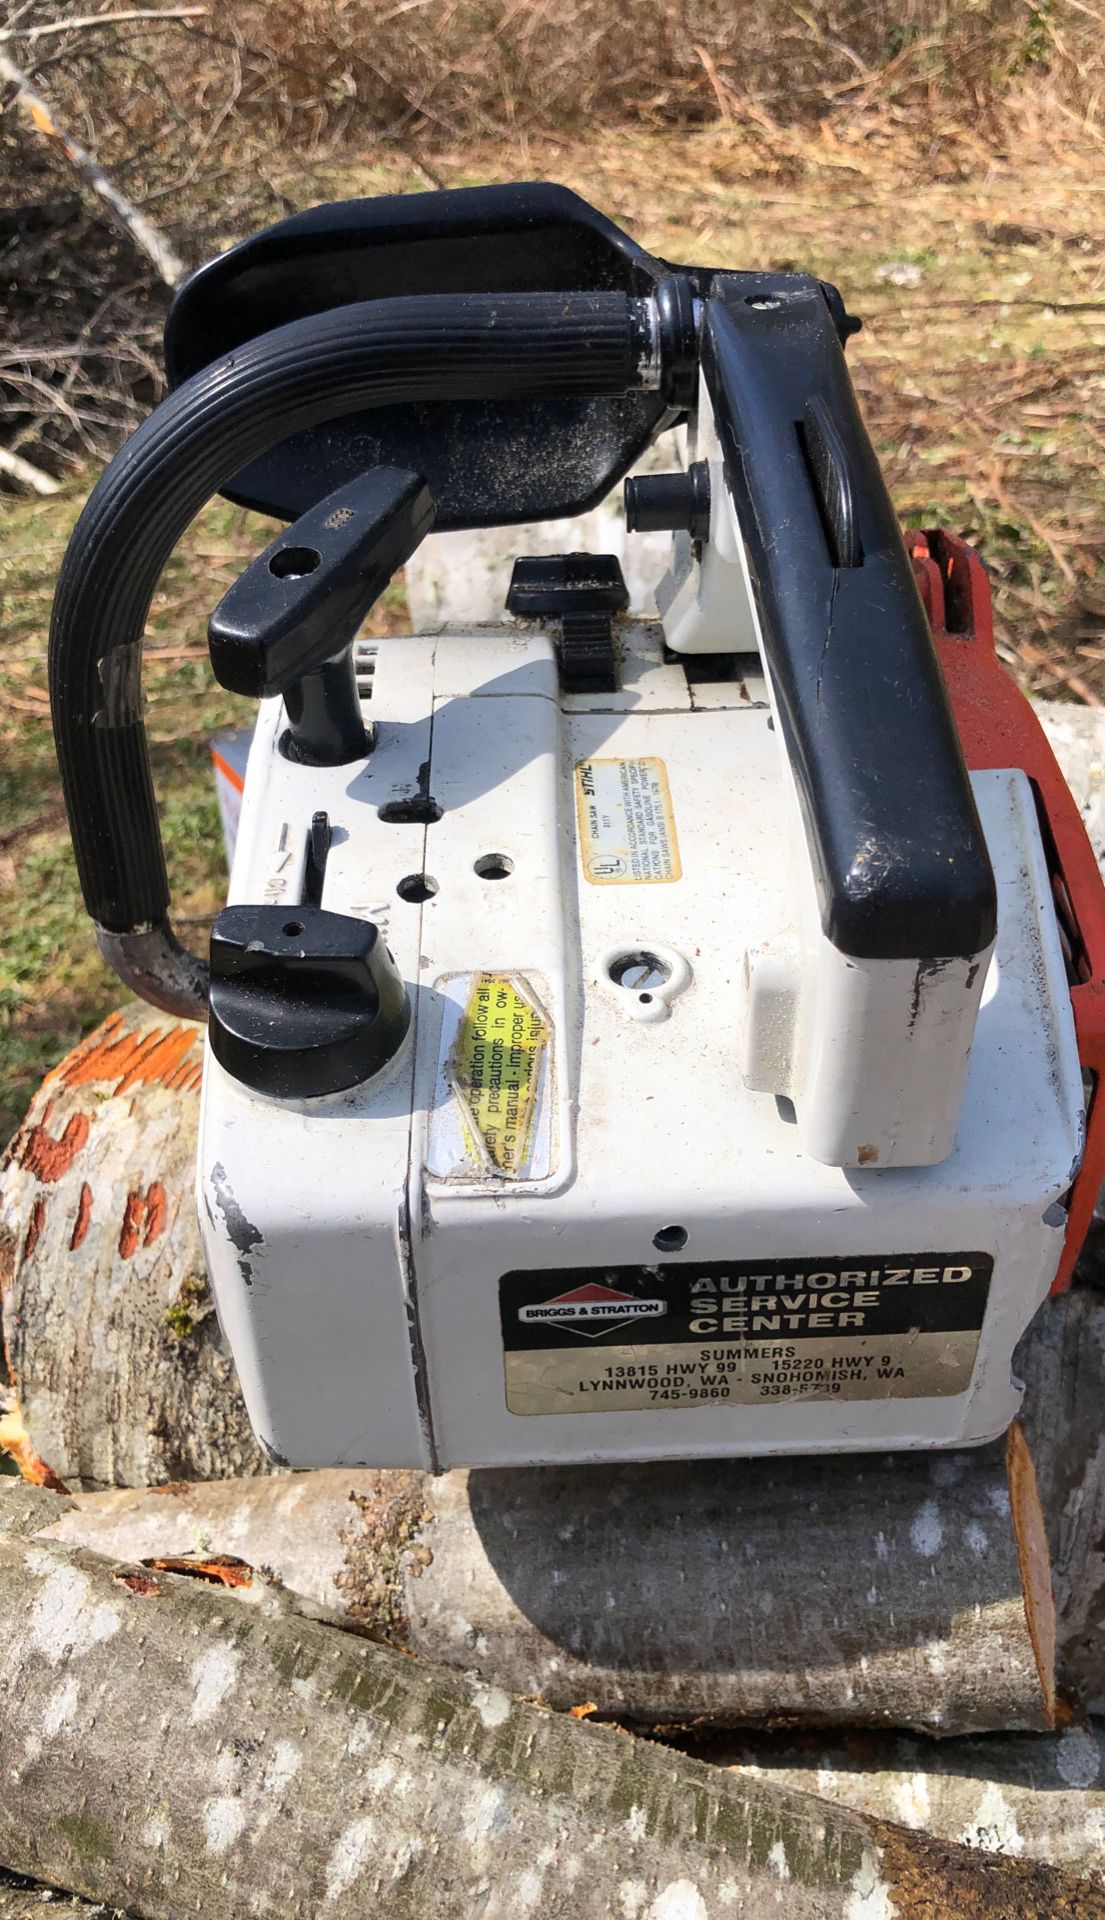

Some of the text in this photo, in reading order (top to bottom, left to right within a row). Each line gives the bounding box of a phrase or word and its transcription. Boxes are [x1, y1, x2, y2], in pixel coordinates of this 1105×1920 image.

[581, 764, 595, 796] STIHL
[620, 762, 629, 792] AMERICAN
[623, 792, 632, 808] WITH
[632, 787, 643, 809] SAFETY
[643, 795, 655, 826] GASOLINE
[590, 805, 599, 839] CHAIN SAW
[625, 809, 637, 849] ACCORDANCE
[635, 812, 648, 845] STANDARD
[648, 831, 658, 845] FOR
[660, 840, 670, 858] SAWS
[633, 859, 642, 880] LISTED
[641, 848, 652, 880] NATIONAL
[652, 851, 663, 880] CATIONS
[662, 859, 673, 879] CHAIN
[476, 988, 490, 1002] all
[496, 988, 508, 1008] ow-
[472, 1005, 488, 1041] follow
[492, 1018, 506, 1028] in
[505, 1013, 526, 1067] improper
[469, 1045, 485, 1104] operation
[488, 1038, 504, 1112] precautions
[505, 1080, 520, 1130] manual
[502, 1135, 516, 1169] ner's
[690, 1266, 972, 1294] AUTHORIZED
[526, 1303, 659, 1318] BRIGGS & STRATTON
[690, 1291, 880, 1314] SERVICE
[689, 1312, 866, 1334] CENTER
[605, 1355, 891, 1378] 13815 HWY 99 15220 HWY 9
[700, 1346, 796, 1362] SUMMERS
[579, 1377, 691, 1392] LYNNWOOD,
[700, 1375, 729, 1387] WA
[751, 1369, 868, 1384] SNOHOMISH,
[877, 1367, 905, 1379] WA
[649, 1387, 731, 1401] 745-9860
